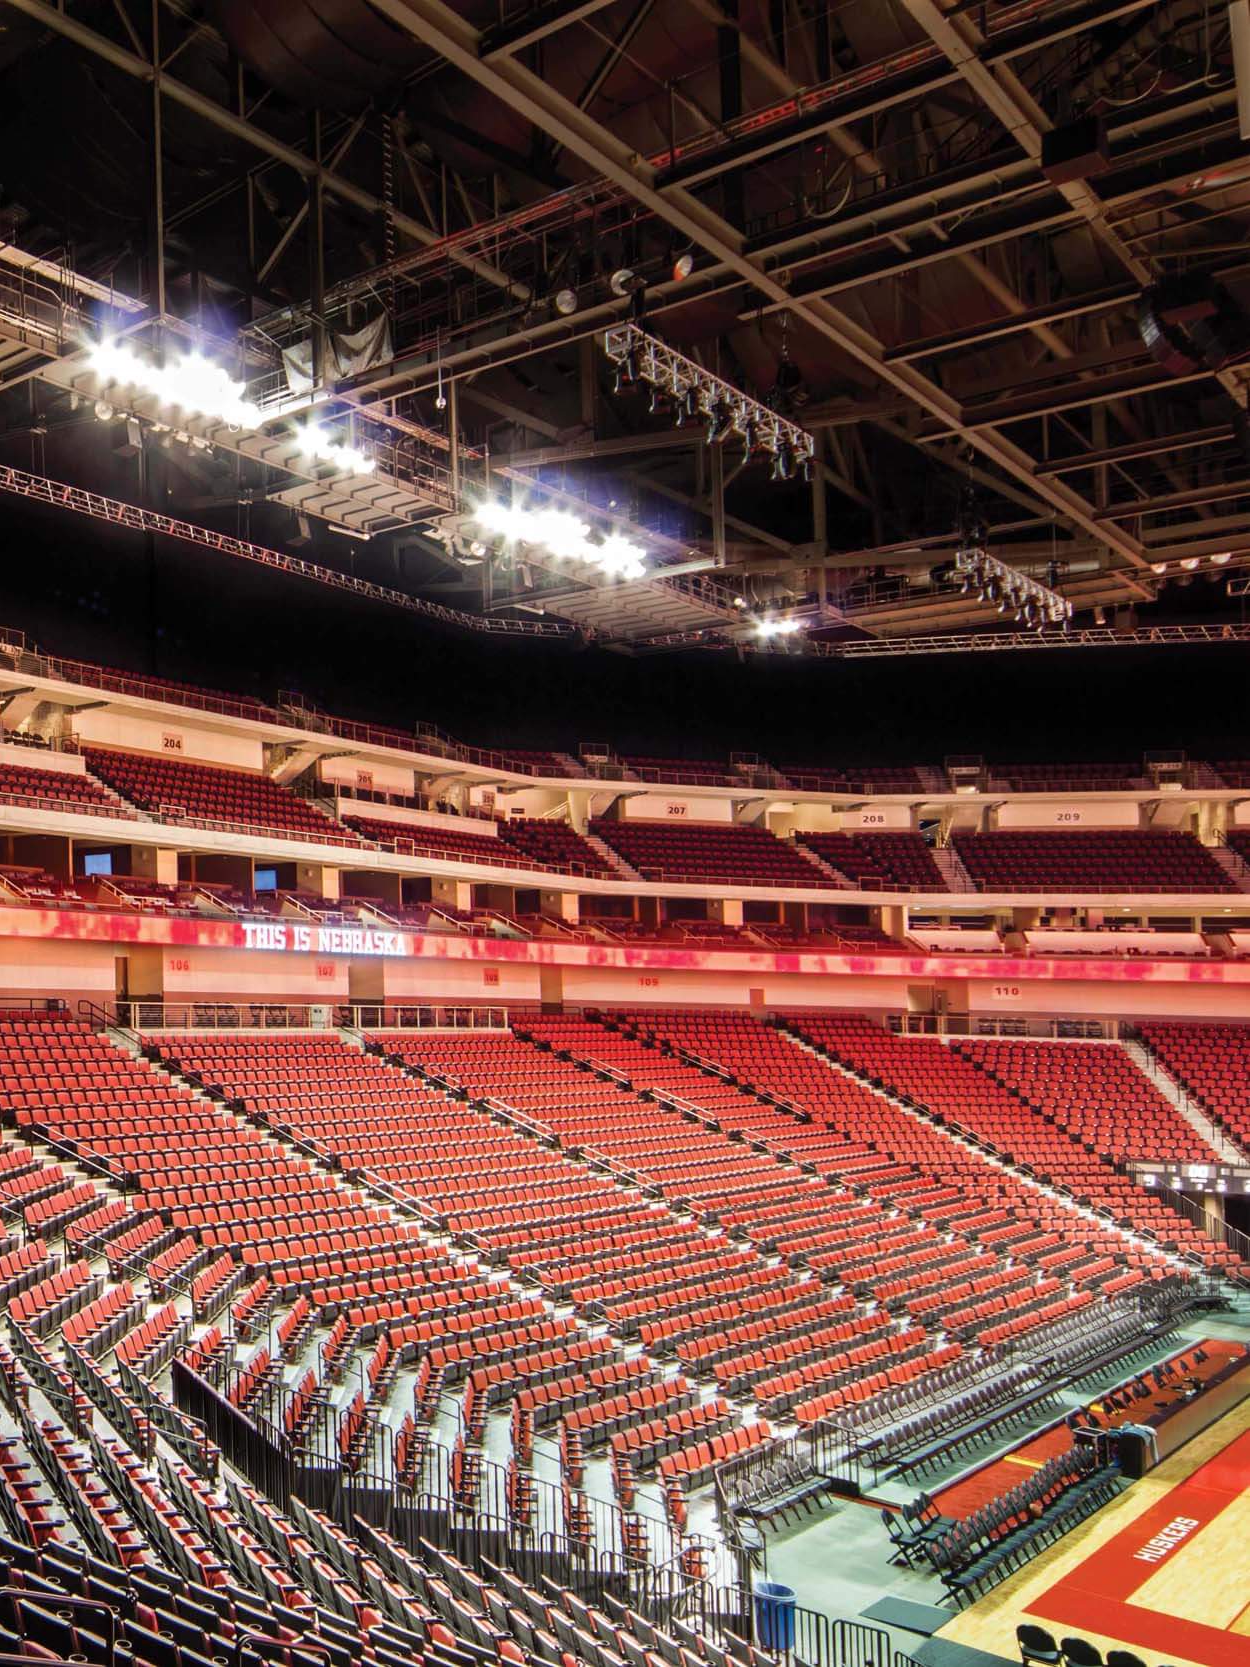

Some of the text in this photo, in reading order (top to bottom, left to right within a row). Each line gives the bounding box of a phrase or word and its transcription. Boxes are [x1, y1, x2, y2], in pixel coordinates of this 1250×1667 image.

[163, 737, 182, 750] 204
[667, 806, 687, 815] 207
[862, 815, 885, 824] 208
[1056, 813, 1081, 822] 209
[242, 923, 407, 956] THIS IS NEBRASKA
[170, 959, 190, 971] 106
[994, 986, 1020, 996] 110
[1133, 1516, 1199, 1563] HUSKERS
